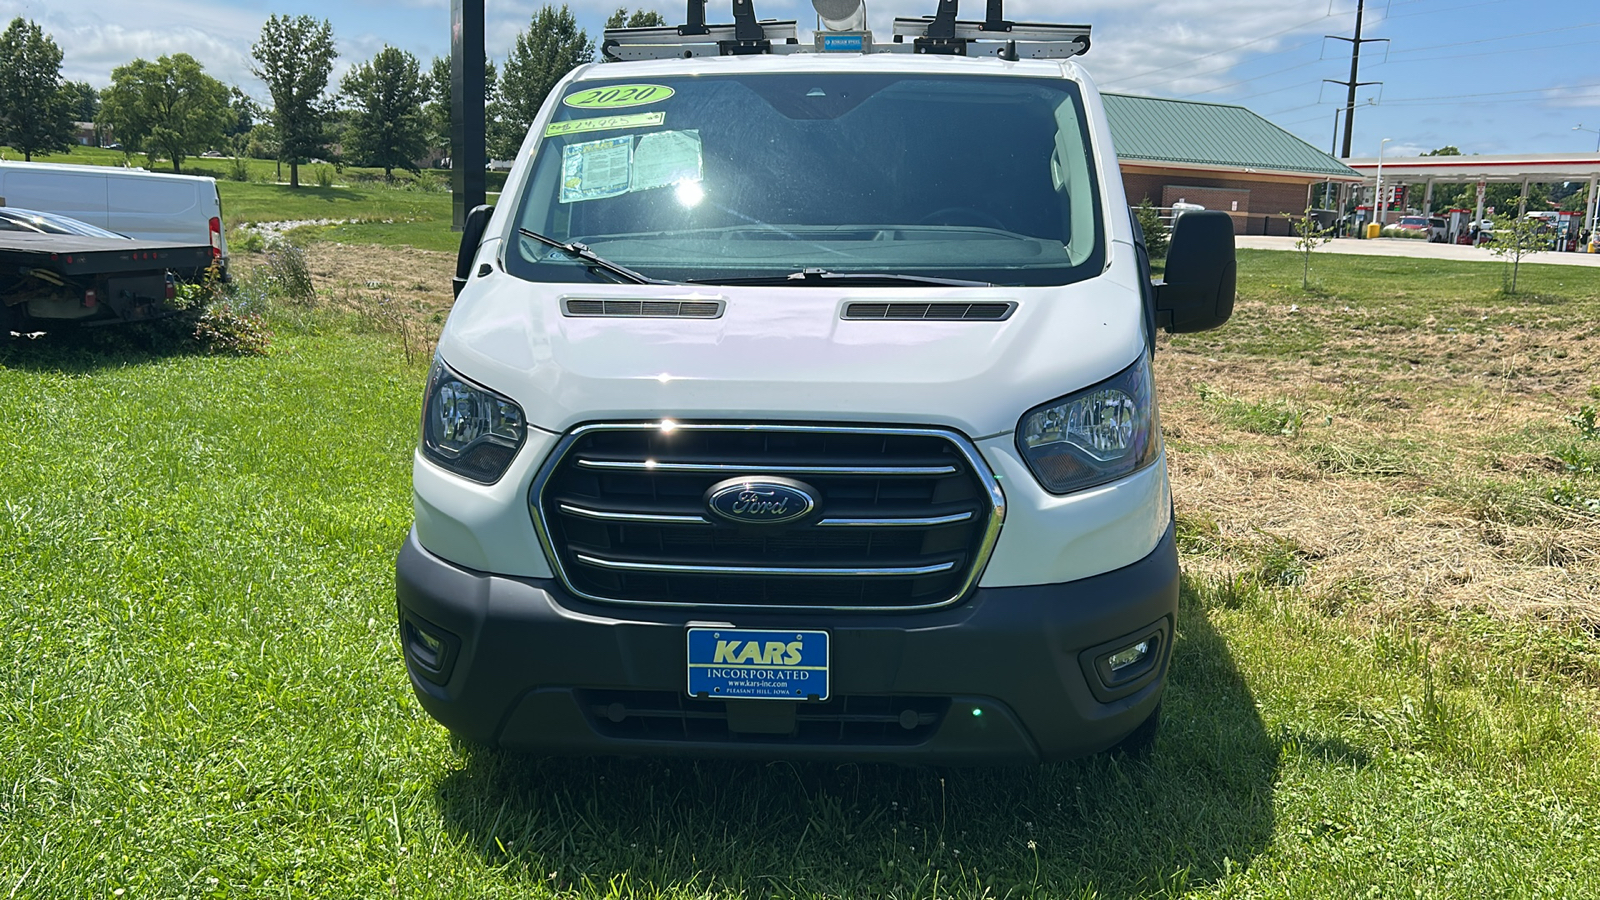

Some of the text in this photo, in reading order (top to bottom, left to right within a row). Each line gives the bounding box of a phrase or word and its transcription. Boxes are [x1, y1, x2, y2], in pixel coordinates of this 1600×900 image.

[577, 86, 657, 104] 2020
[732, 490, 788, 514] Ford
[713, 640, 803, 665] KARS
[707, 668, 809, 680] INCORPORATED
[728, 679, 788, 688] www.kars-inc.com
